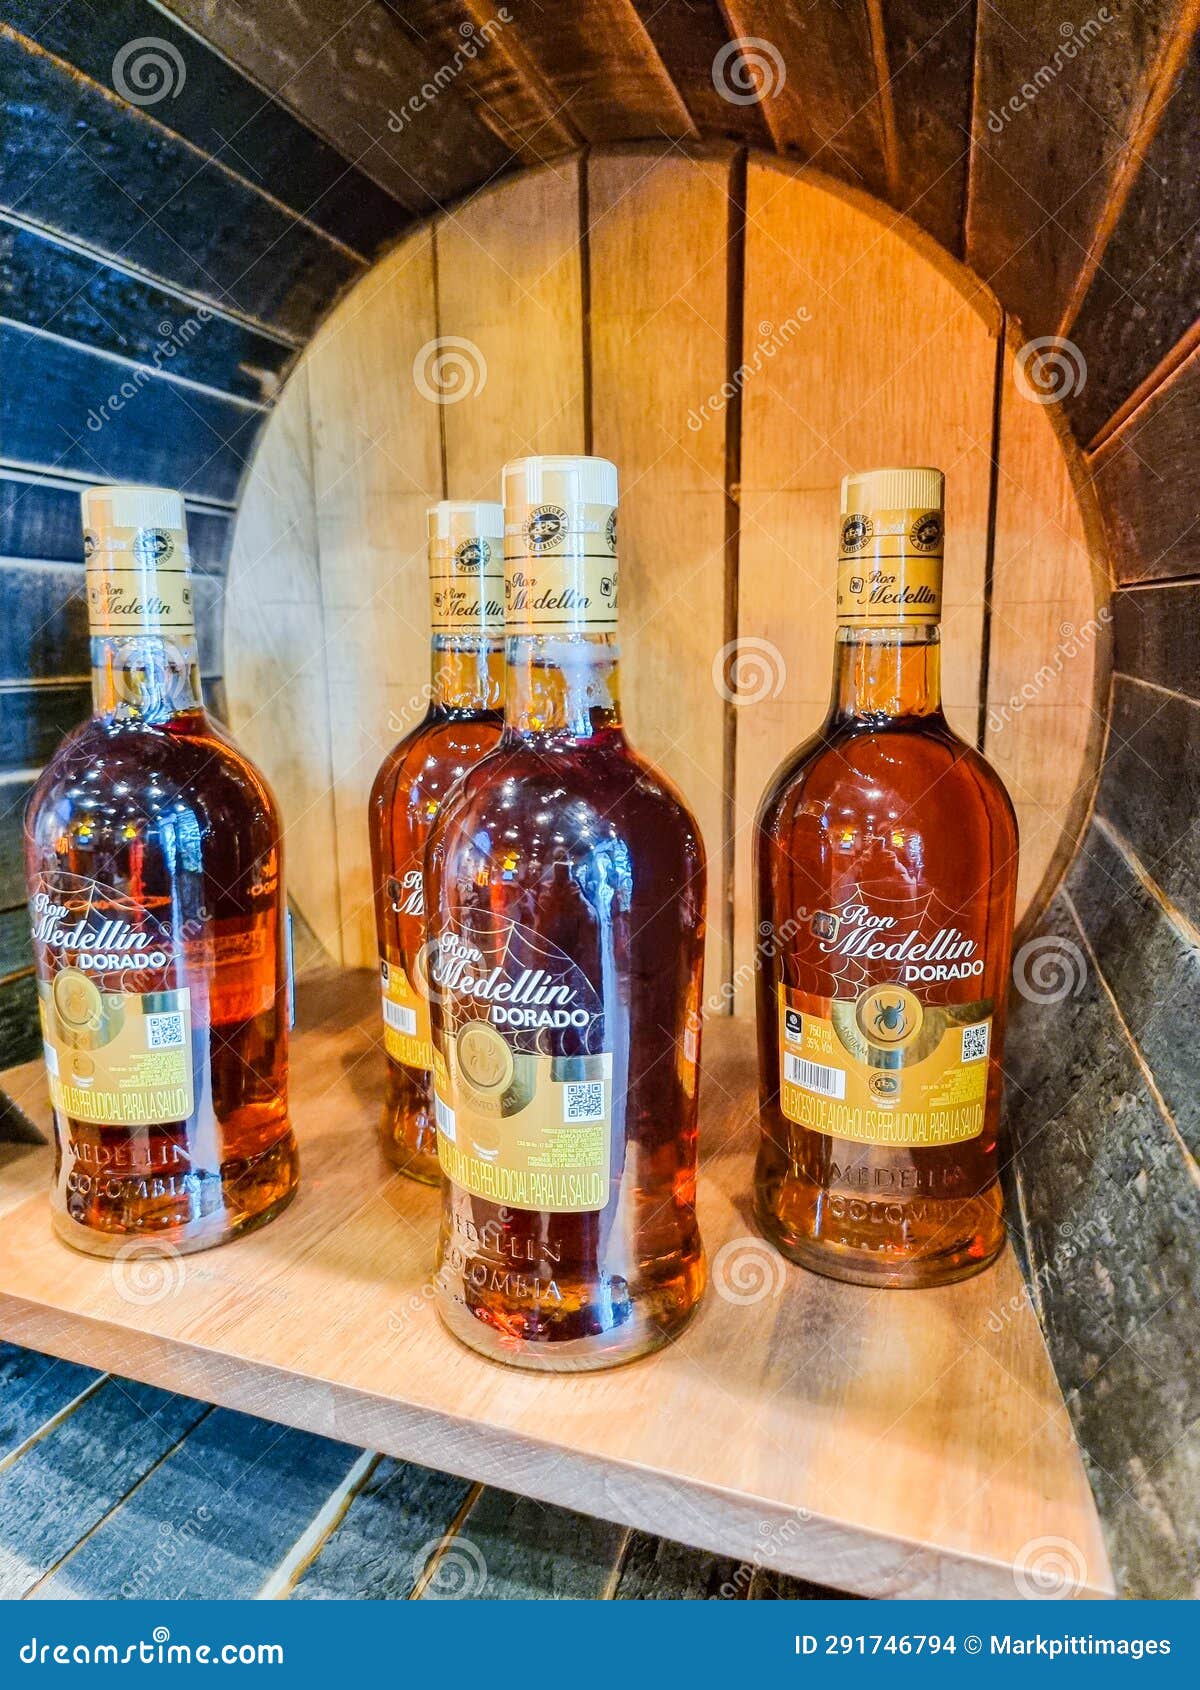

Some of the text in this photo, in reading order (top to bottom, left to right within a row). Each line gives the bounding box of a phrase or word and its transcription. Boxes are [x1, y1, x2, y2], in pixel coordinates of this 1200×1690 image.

[511, 572, 538, 588] Ron
[865, 570, 896, 584] Ron
[443, 588, 467, 600] Ron
[33, 892, 70, 918] Ron
[840, 904, 898, 929] Ron
[438, 932, 482, 962] Ron
[79, 951, 167, 970] DORADO
[905, 959, 984, 982] DORADO
[492, 1005, 590, 1028] DORADO
[123, 1092, 146, 1120] PARA
[146, 1091, 156, 1119] LA
[156, 1087, 185, 1117] SALUD
[790, 1089, 816, 1126] EXCESO
[816, 1099, 827, 1129] DE
[827, 1102, 864, 1138] ALCOHOL
[865, 1110, 877, 1139] ES
[877, 1112, 929, 1142] PERJUDICIAL
[929, 1111, 950, 1141] PARA
[950, 1109, 960, 1139] LA
[960, 1103, 981, 1137] SALUD
[471, 1158, 480, 1192] ES
[480, 1162, 530, 1204] PERJUDICIAL
[530, 1172, 555, 1206] PARA
[555, 1173, 569, 1207] LA
[569, 1172, 600, 1207] SALUD
